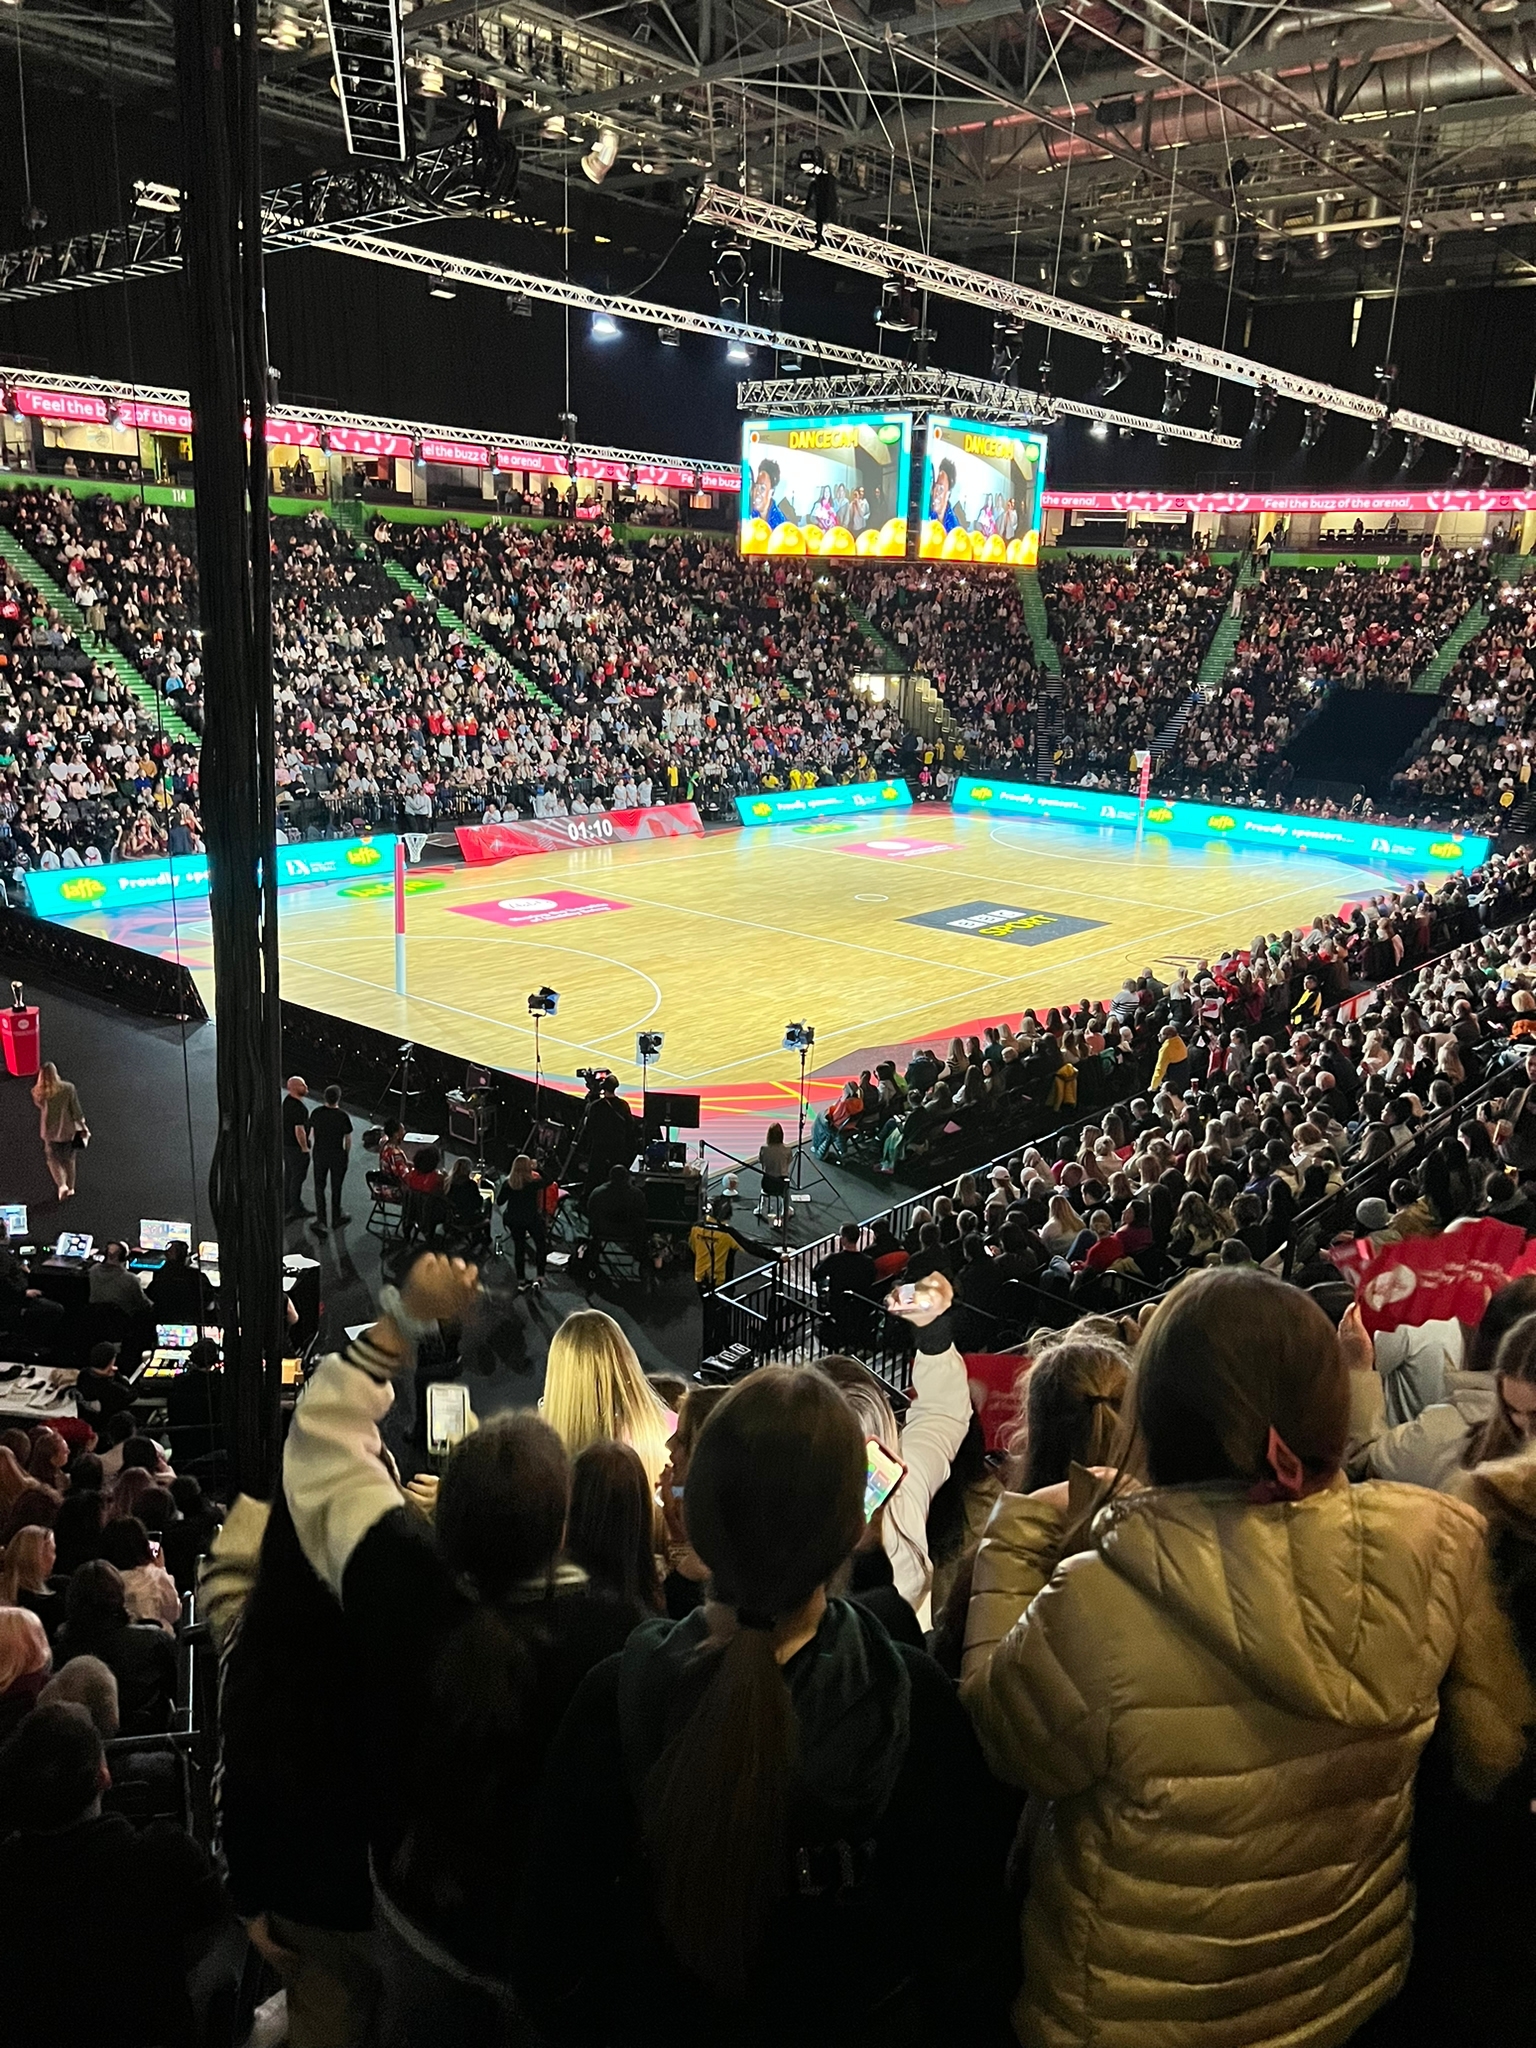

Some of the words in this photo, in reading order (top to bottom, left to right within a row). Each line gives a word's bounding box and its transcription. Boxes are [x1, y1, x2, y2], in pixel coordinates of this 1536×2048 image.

[67, 399, 91, 415] the
[136, 409, 150, 423] of
[152, 412, 177, 426] the
[436, 445, 452, 457] the
[455, 447, 480, 461] buzz
[498, 453, 510, 464] he
[718, 477, 742, 489] buzz
[172, 489, 186, 503] 114
[1042, 494, 1060, 505] the
[1290, 497, 1308, 509] the
[1310, 497, 1336, 509] buzz
[1338, 497, 1350, 509] of
[1352, 497, 1370, 509] the
[567, 819, 613, 842] 01:10
[118, 872, 181, 891] Proudly
[978, 914, 1058, 937] SPORT
